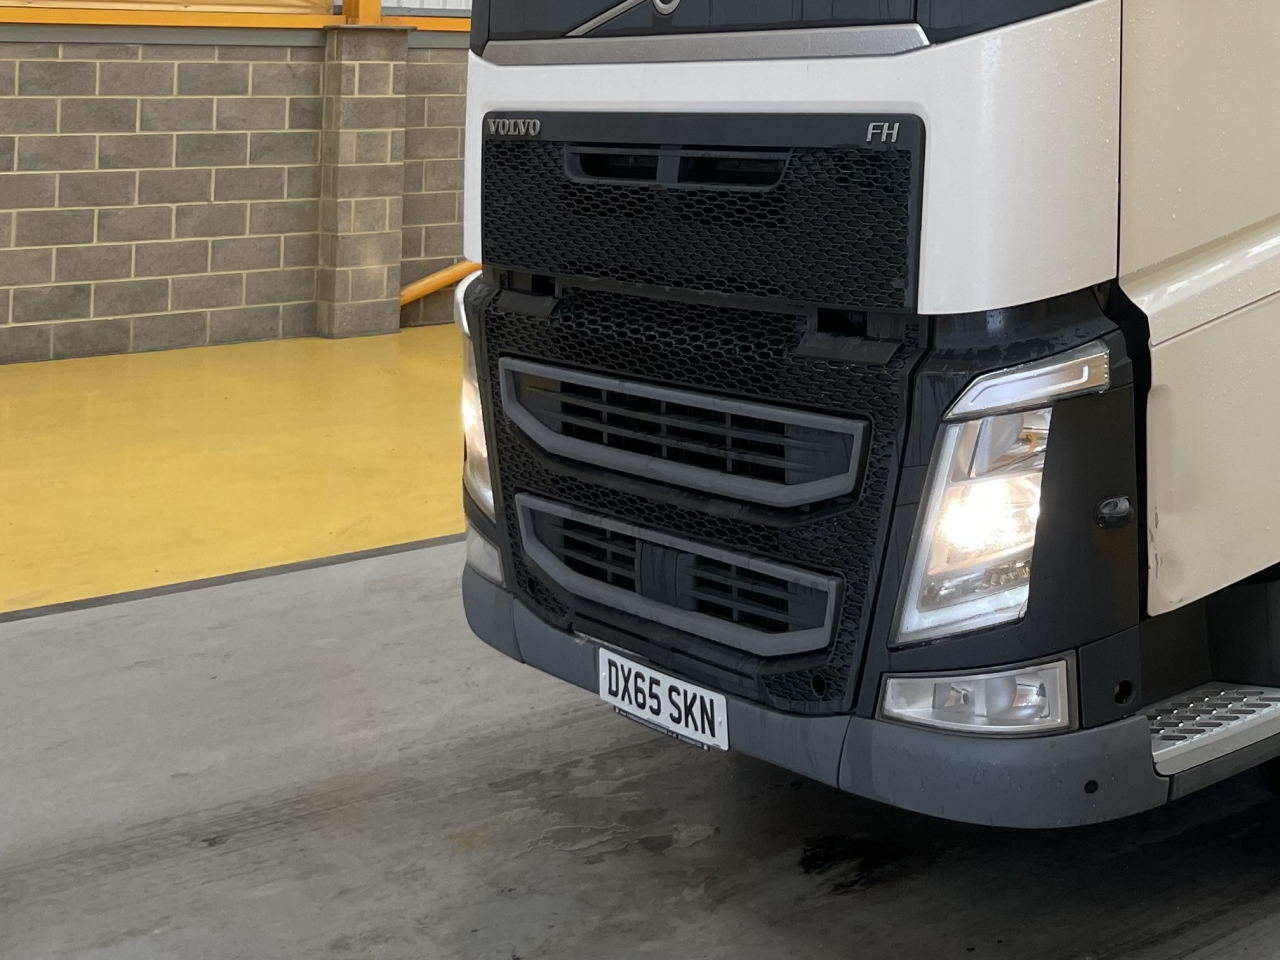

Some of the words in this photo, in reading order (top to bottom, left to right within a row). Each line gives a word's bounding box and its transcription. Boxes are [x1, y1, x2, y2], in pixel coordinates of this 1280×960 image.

[487, 118, 541, 136] VOLVO
[866, 121, 900, 143] FH
[608, 658, 662, 717] DX65
[668, 684, 716, 738] SKN
